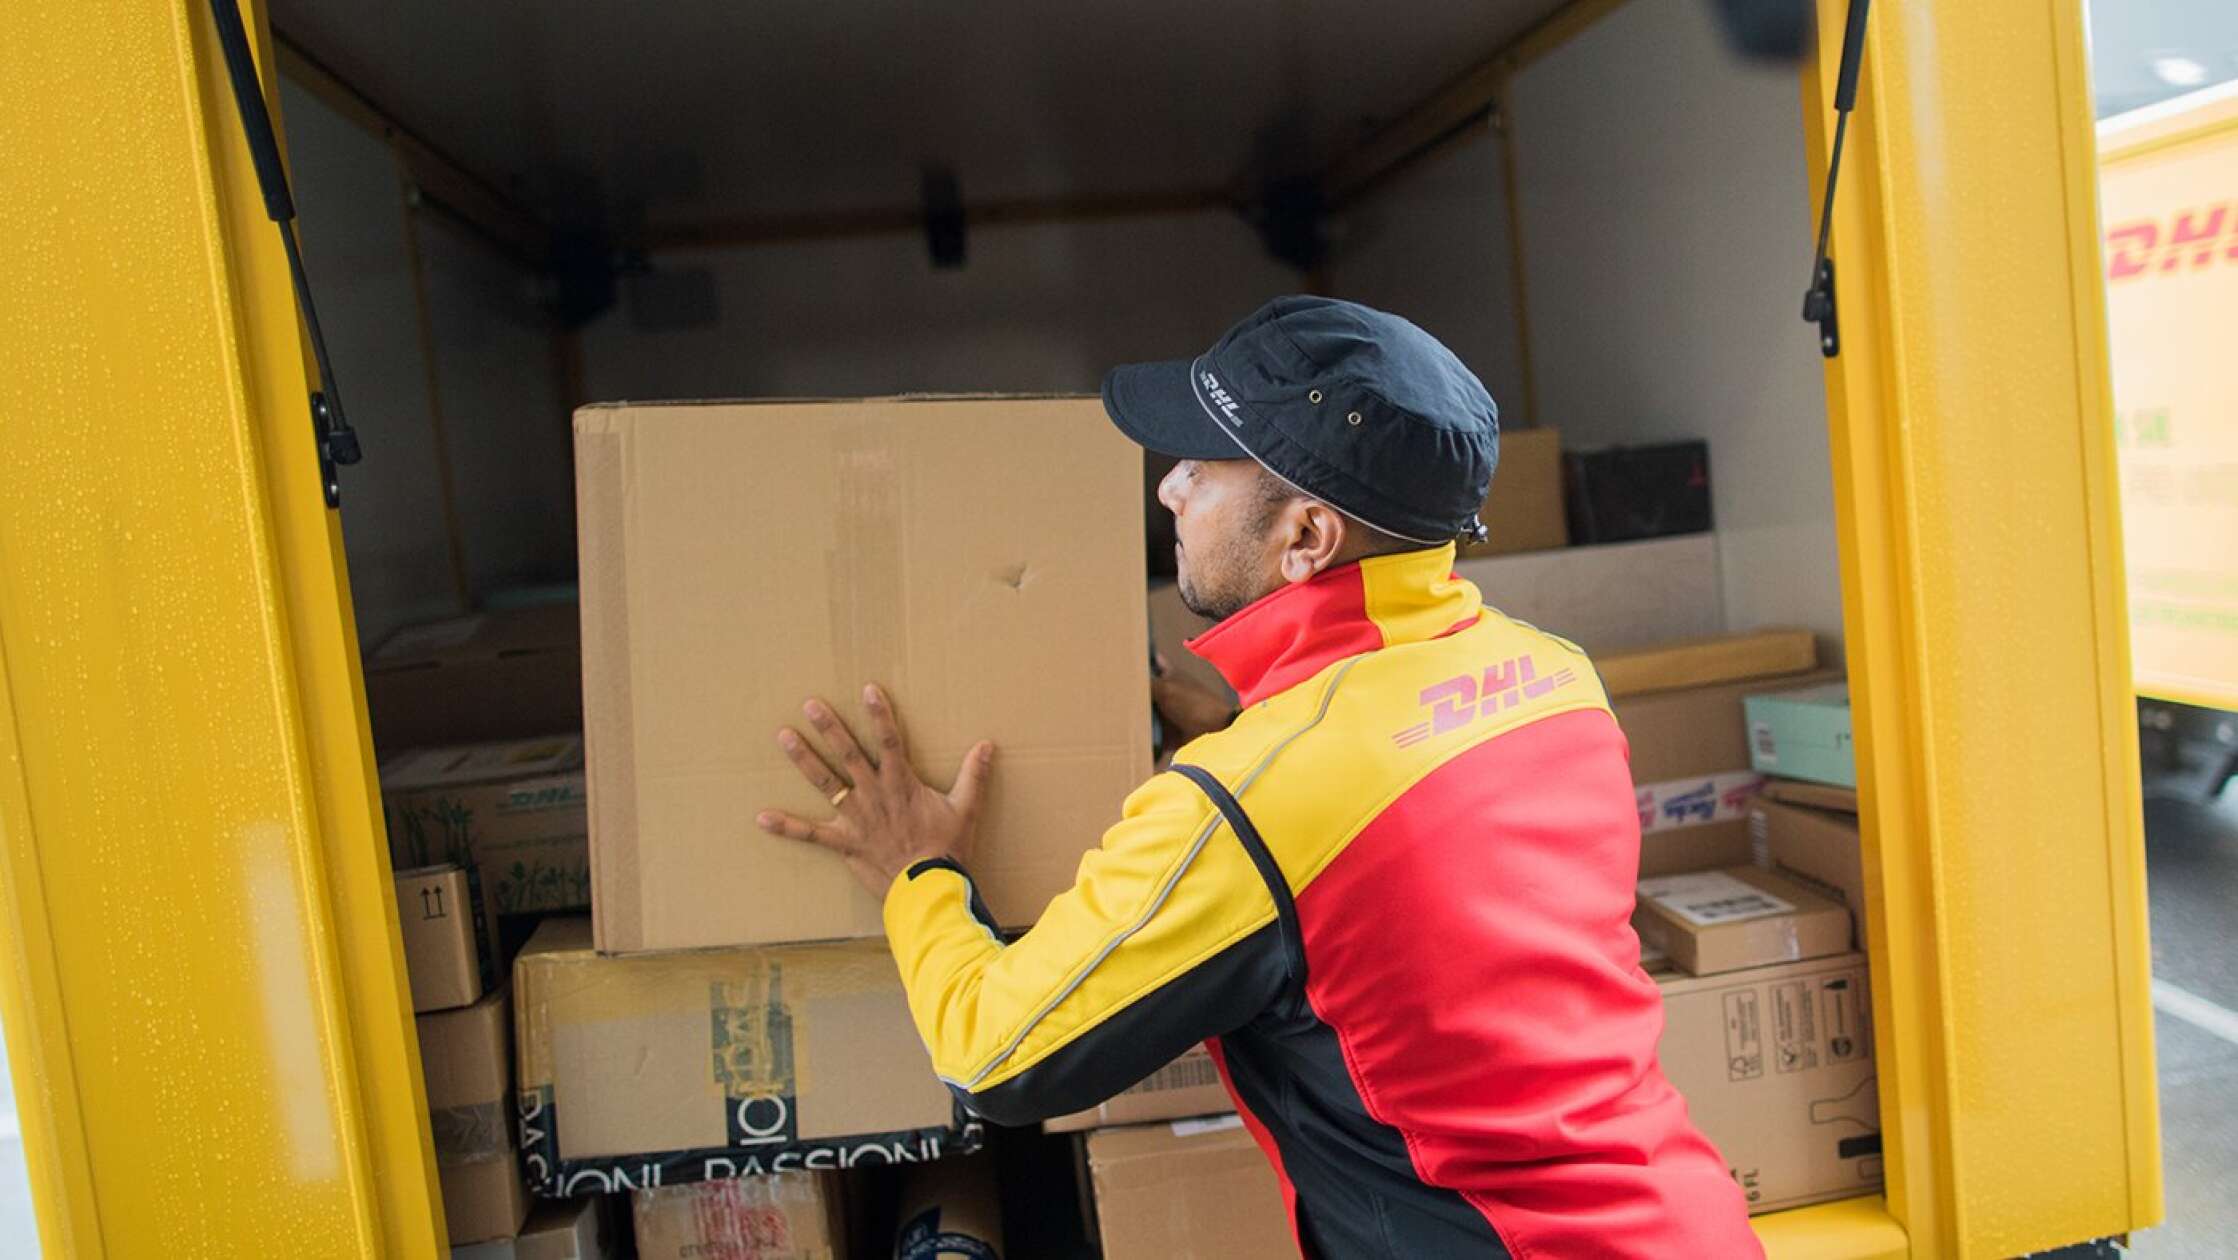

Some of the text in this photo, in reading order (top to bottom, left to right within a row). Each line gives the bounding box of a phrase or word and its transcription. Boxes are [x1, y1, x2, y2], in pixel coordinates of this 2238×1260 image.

[2108, 203, 2238, 279] DH
[1201, 372, 1241, 420] DHL
[1420, 654, 1555, 736] DHL
